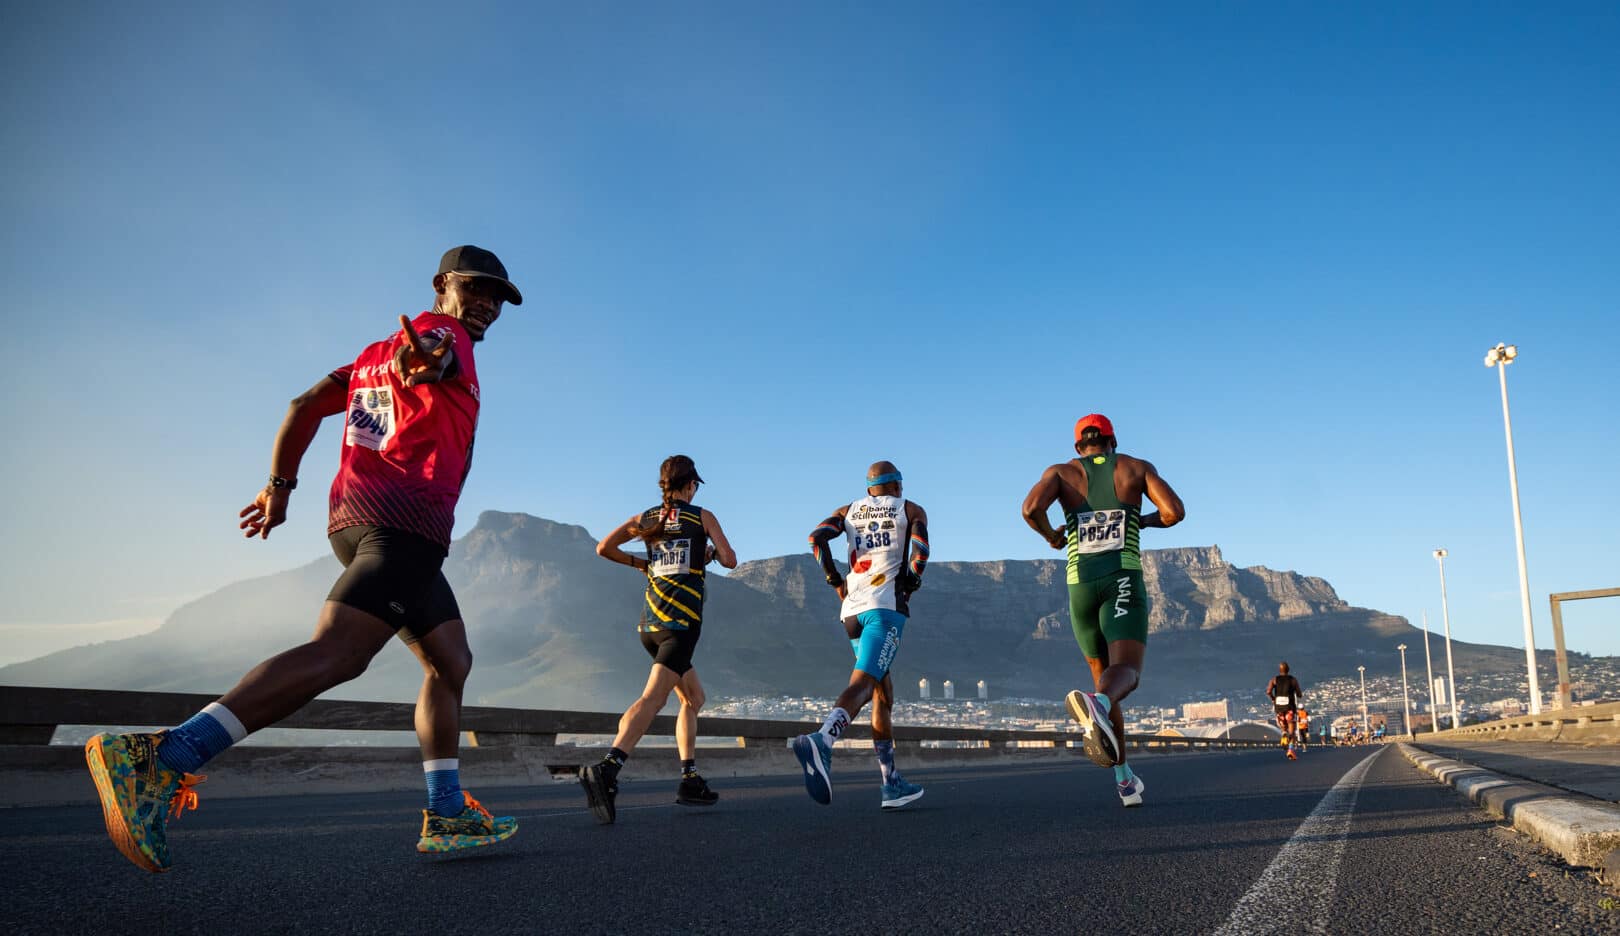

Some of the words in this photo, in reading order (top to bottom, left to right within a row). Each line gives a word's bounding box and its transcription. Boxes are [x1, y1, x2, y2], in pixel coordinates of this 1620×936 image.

[851, 511, 898, 520] Stillwater
[860, 505, 897, 513] Sibanye
[855, 536, 862, 551] P
[865, 532, 891, 549] 338
[1114, 575, 1132, 619] NALA
